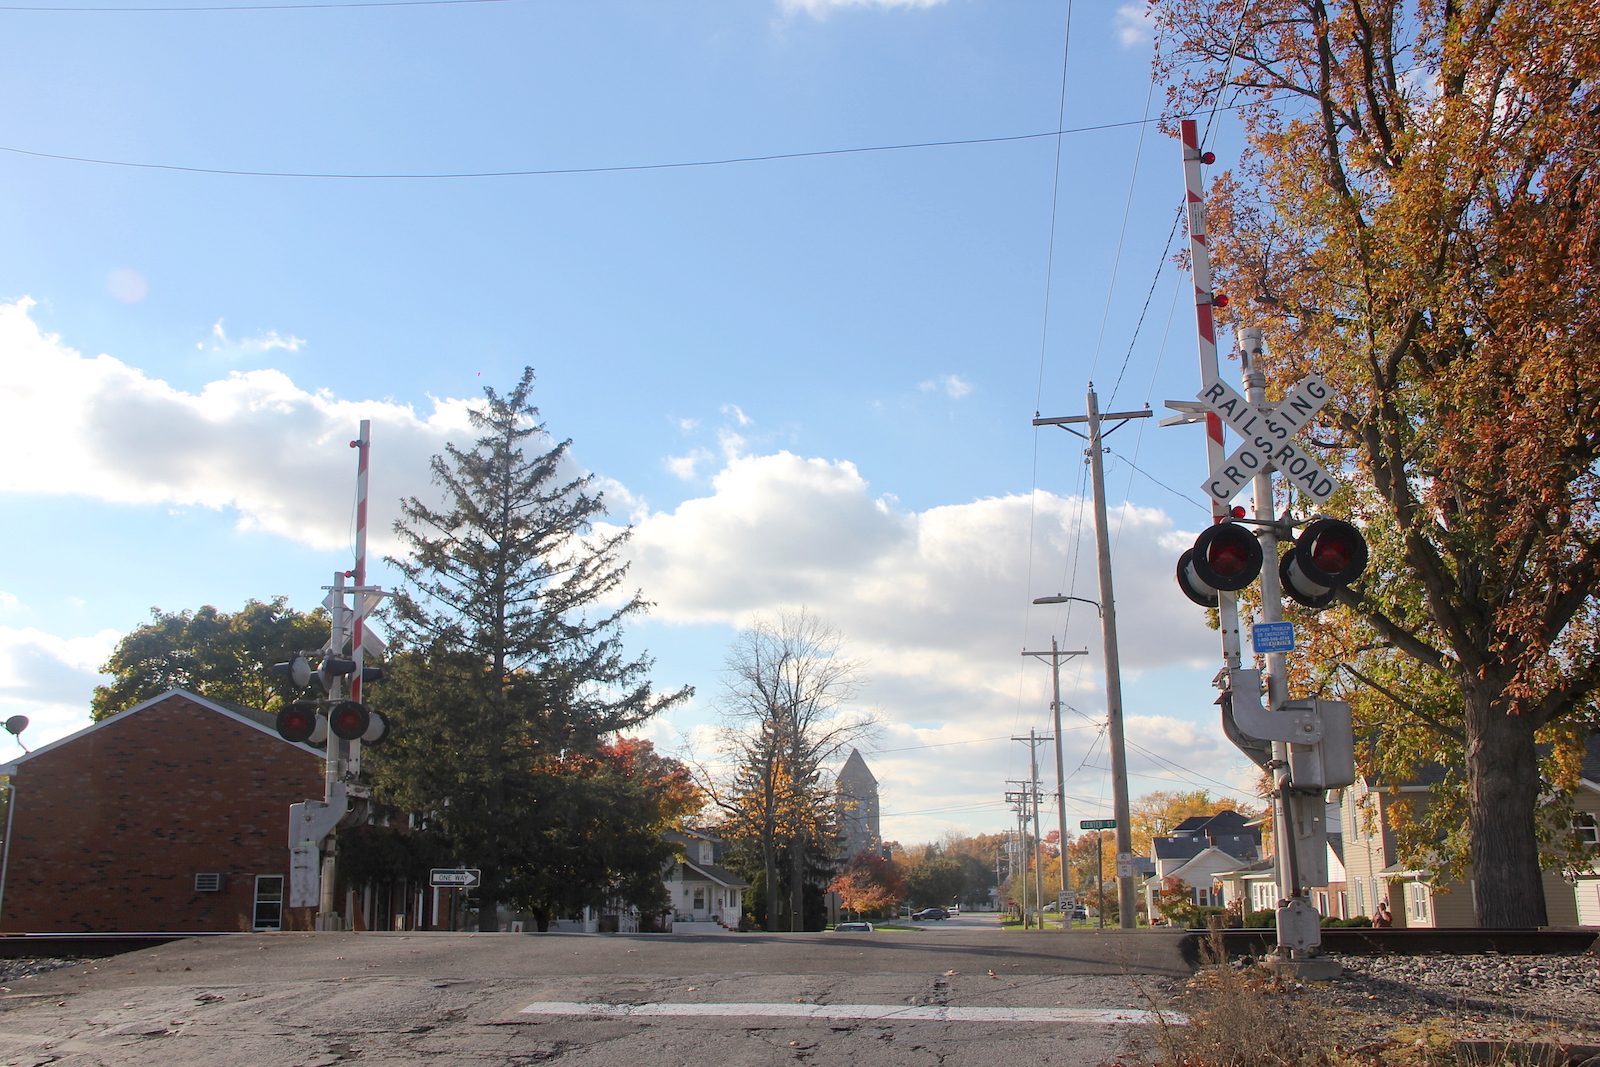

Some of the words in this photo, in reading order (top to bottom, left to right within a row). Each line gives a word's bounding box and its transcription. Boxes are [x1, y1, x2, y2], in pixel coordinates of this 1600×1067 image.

[1204, 382, 1258, 436] RAIL
[1274, 444, 1333, 497] ROAD
[1210, 381, 1326, 499] CROSSING
[1106, 820, 1114, 828] ST
[1060, 901, 1074, 910] 25
